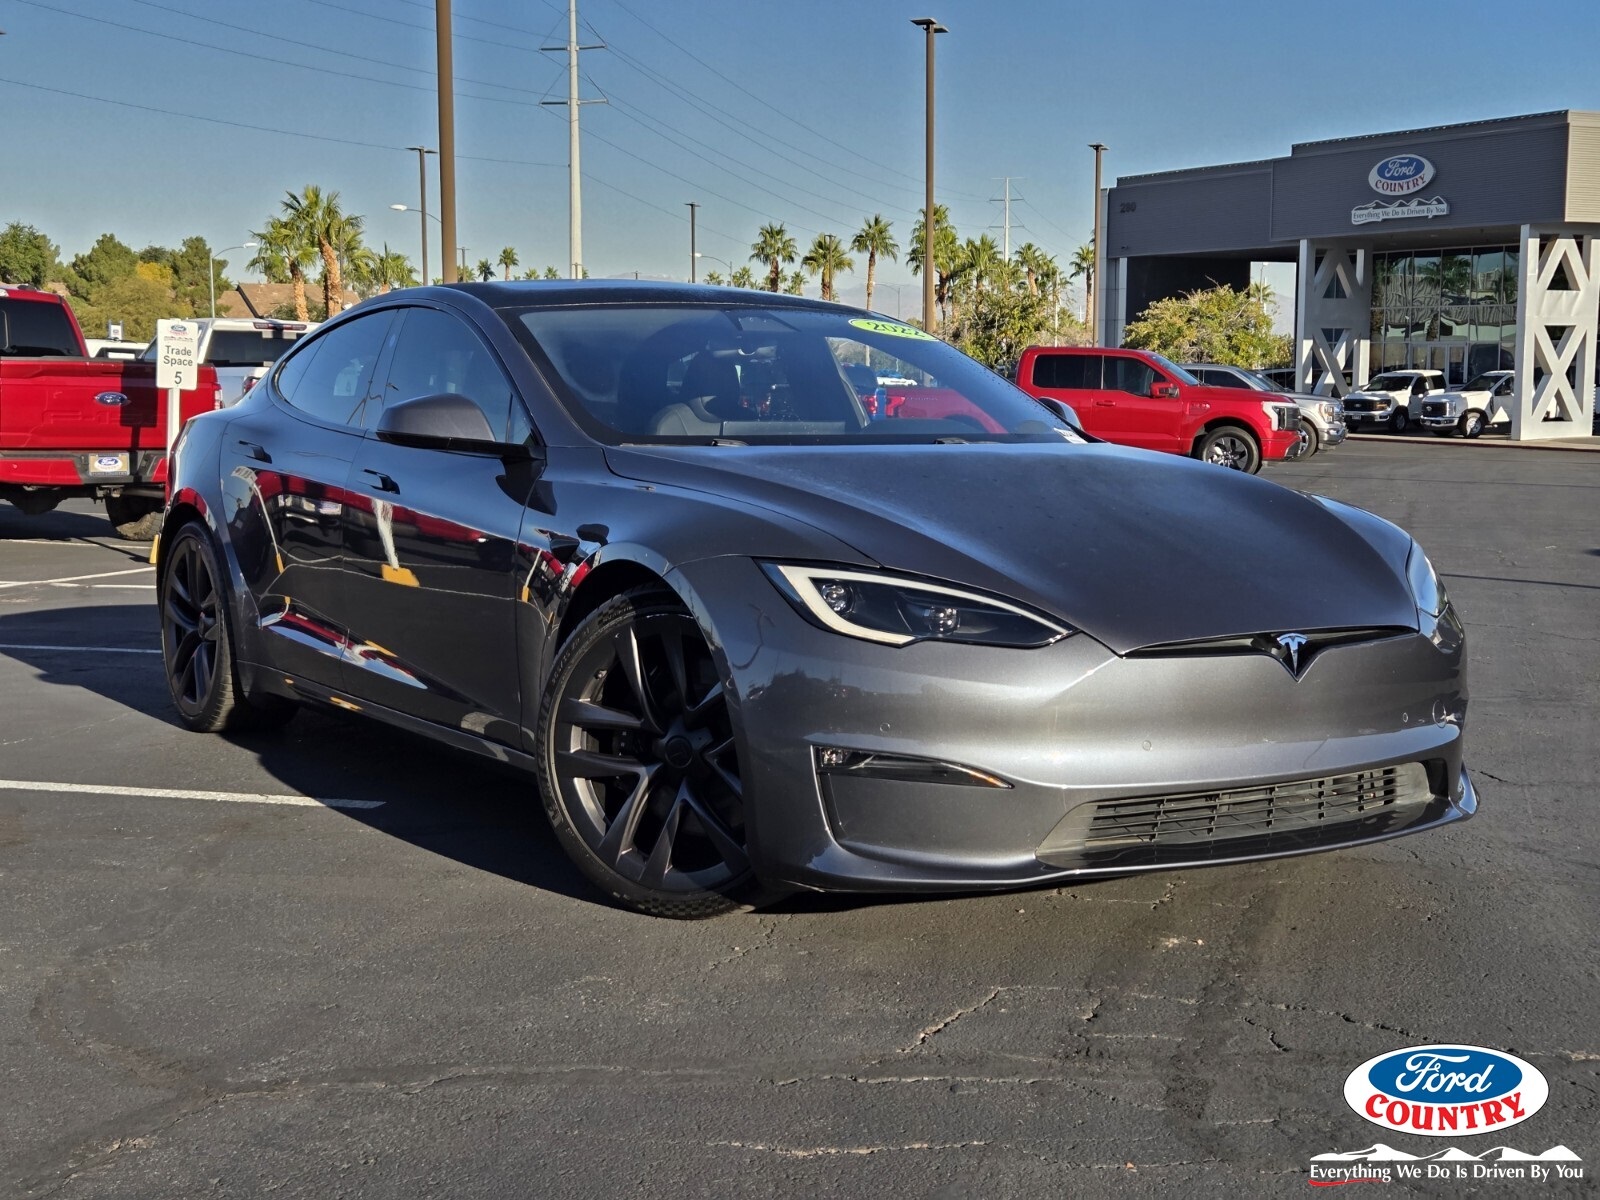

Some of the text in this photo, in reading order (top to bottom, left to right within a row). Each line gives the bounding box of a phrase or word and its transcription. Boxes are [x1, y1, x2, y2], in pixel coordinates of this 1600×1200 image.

[1385, 159, 1416, 177] Ford
[1375, 173, 1427, 192] COUNTRY
[1353, 211, 1381, 219] Everything
[1407, 207, 1425, 215] Driven
[1426, 206, 1433, 215] By
[866, 321, 926, 338] 2022
[165, 345, 192, 356] Trade
[163, 355, 193, 367] Space
[174, 371, 182, 385] 5
